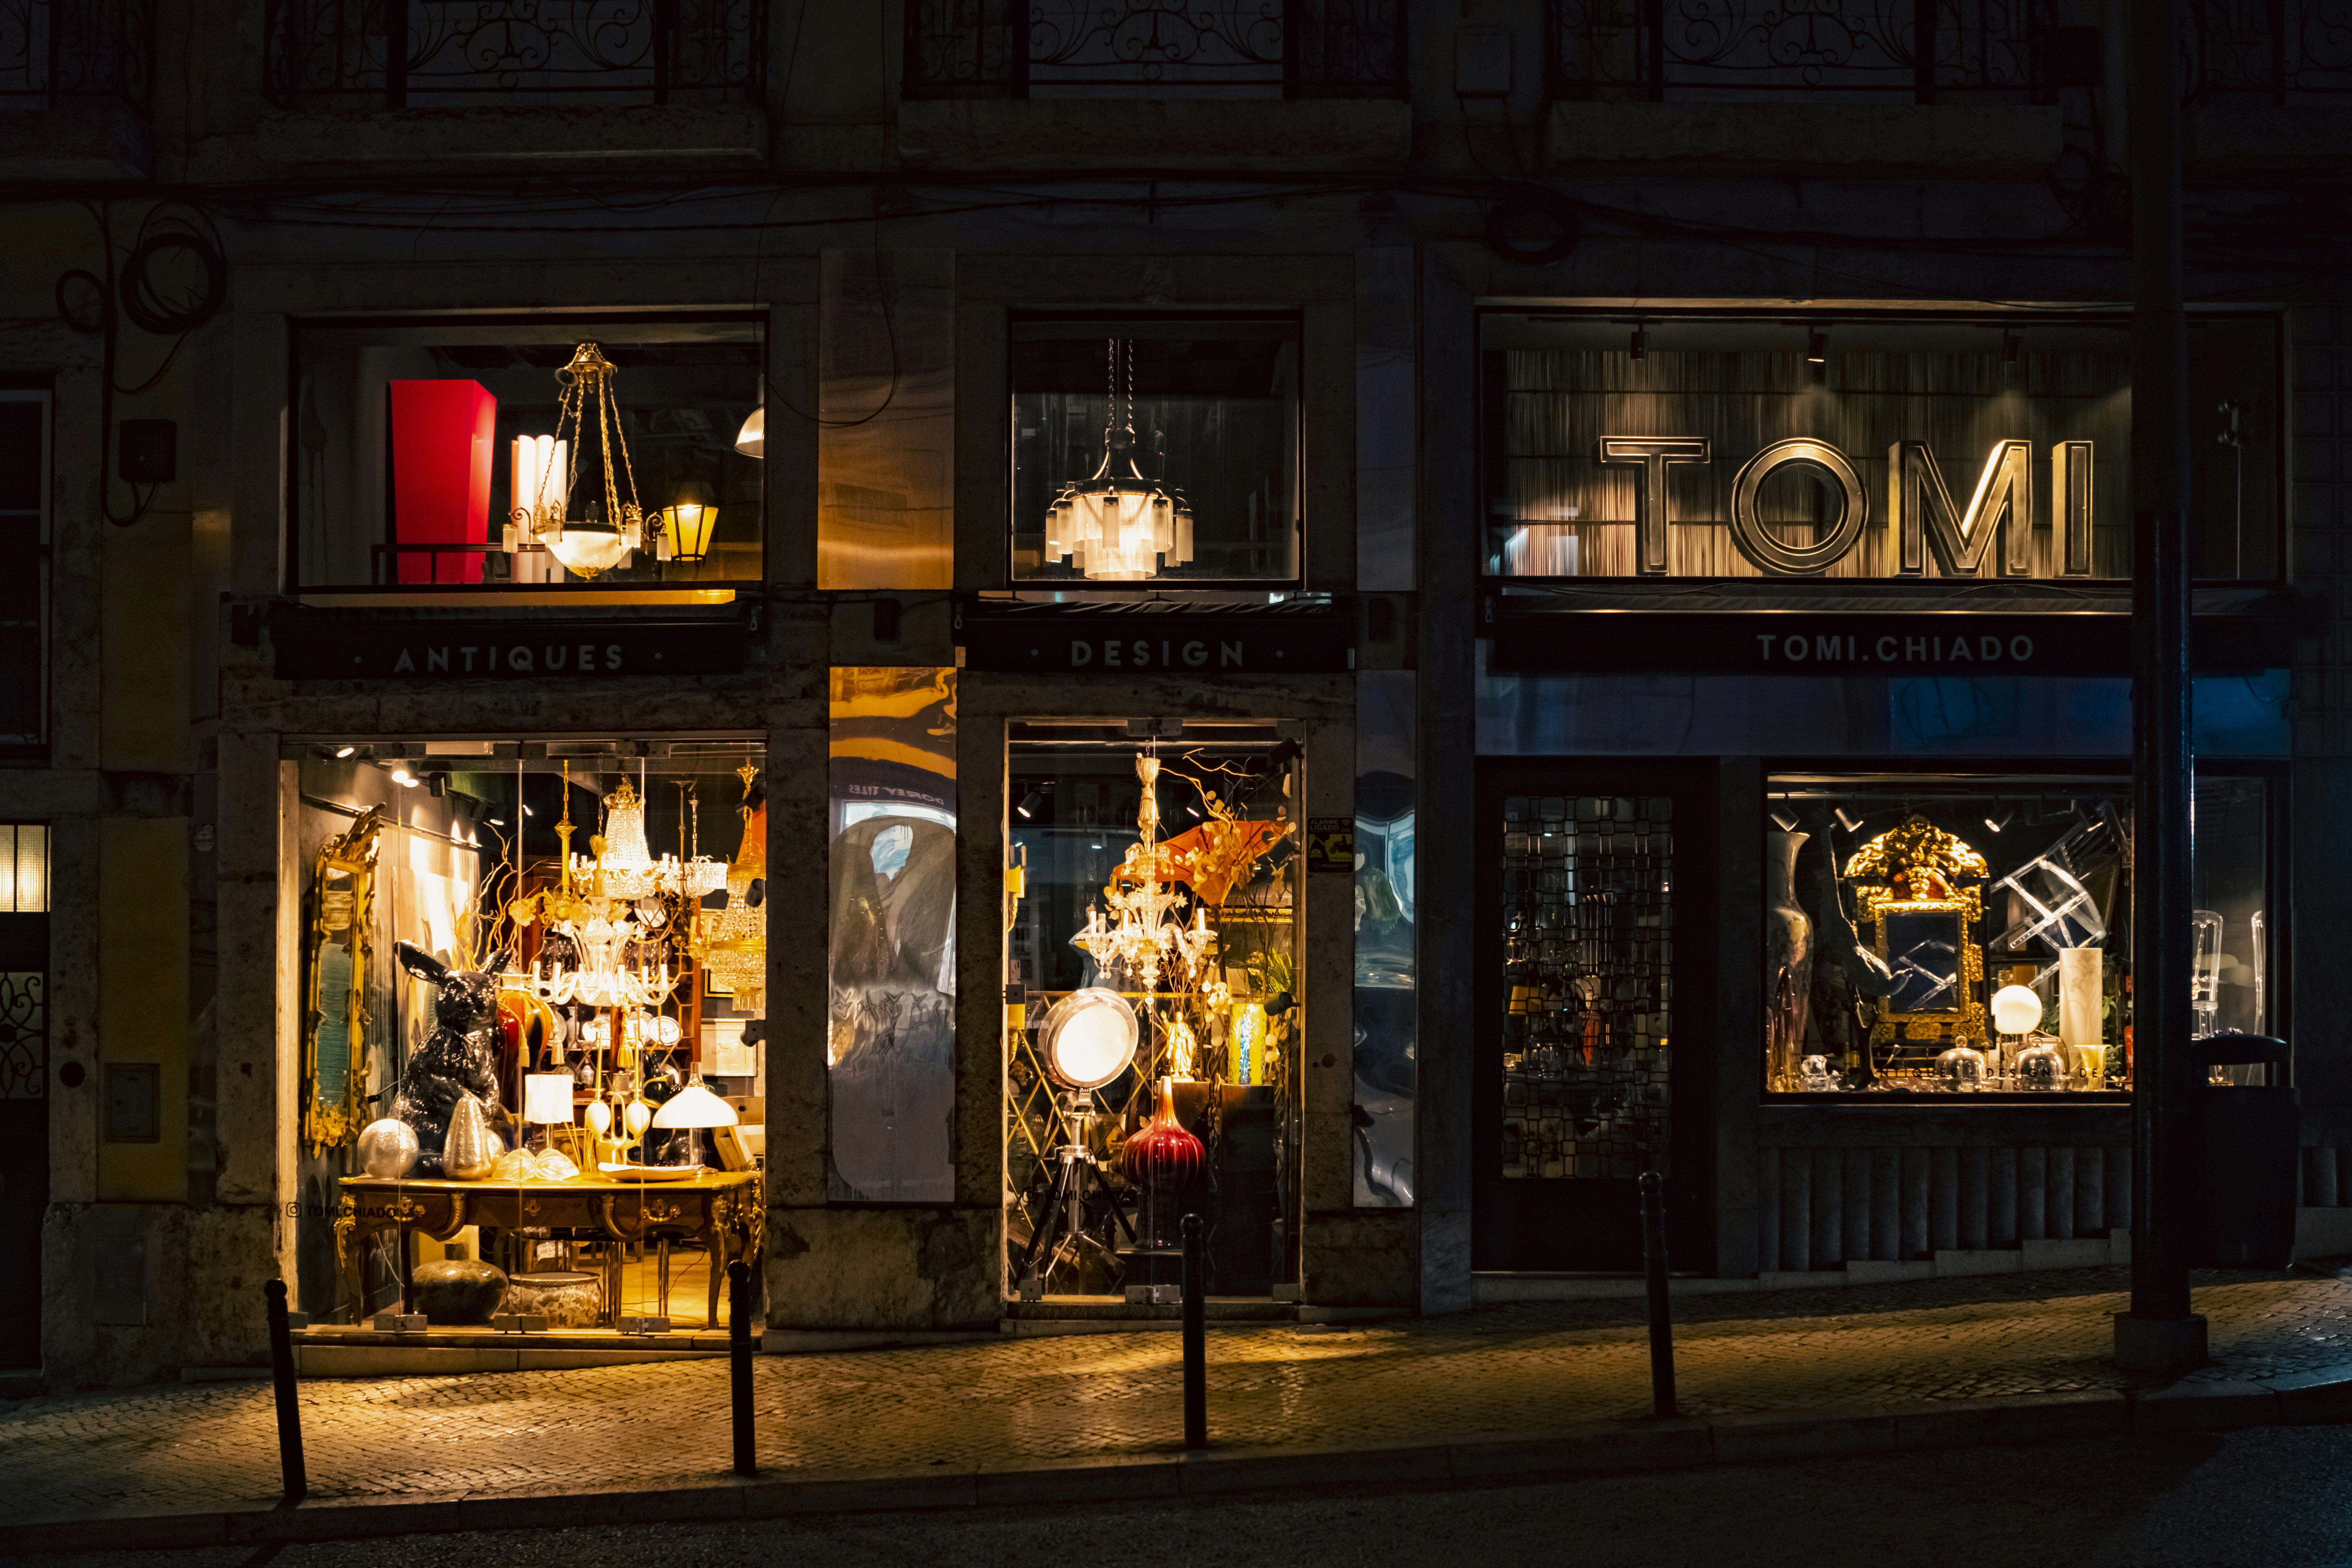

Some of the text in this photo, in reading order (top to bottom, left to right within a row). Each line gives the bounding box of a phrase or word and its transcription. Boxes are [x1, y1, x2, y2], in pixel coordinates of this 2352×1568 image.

[1594, 436, 2093, 577] TOMI
[393, 644, 623, 672] ANTIQUES
[1071, 640, 1243, 667] DESIGN
[1756, 634, 2034, 662] TOMI.CHIADO
[1879, 1067, 1957, 1078] NTIQUES
[1986, 1067, 2051, 1078] DESIGN
[306, 1205, 396, 1218] TOMI.CHIADO
